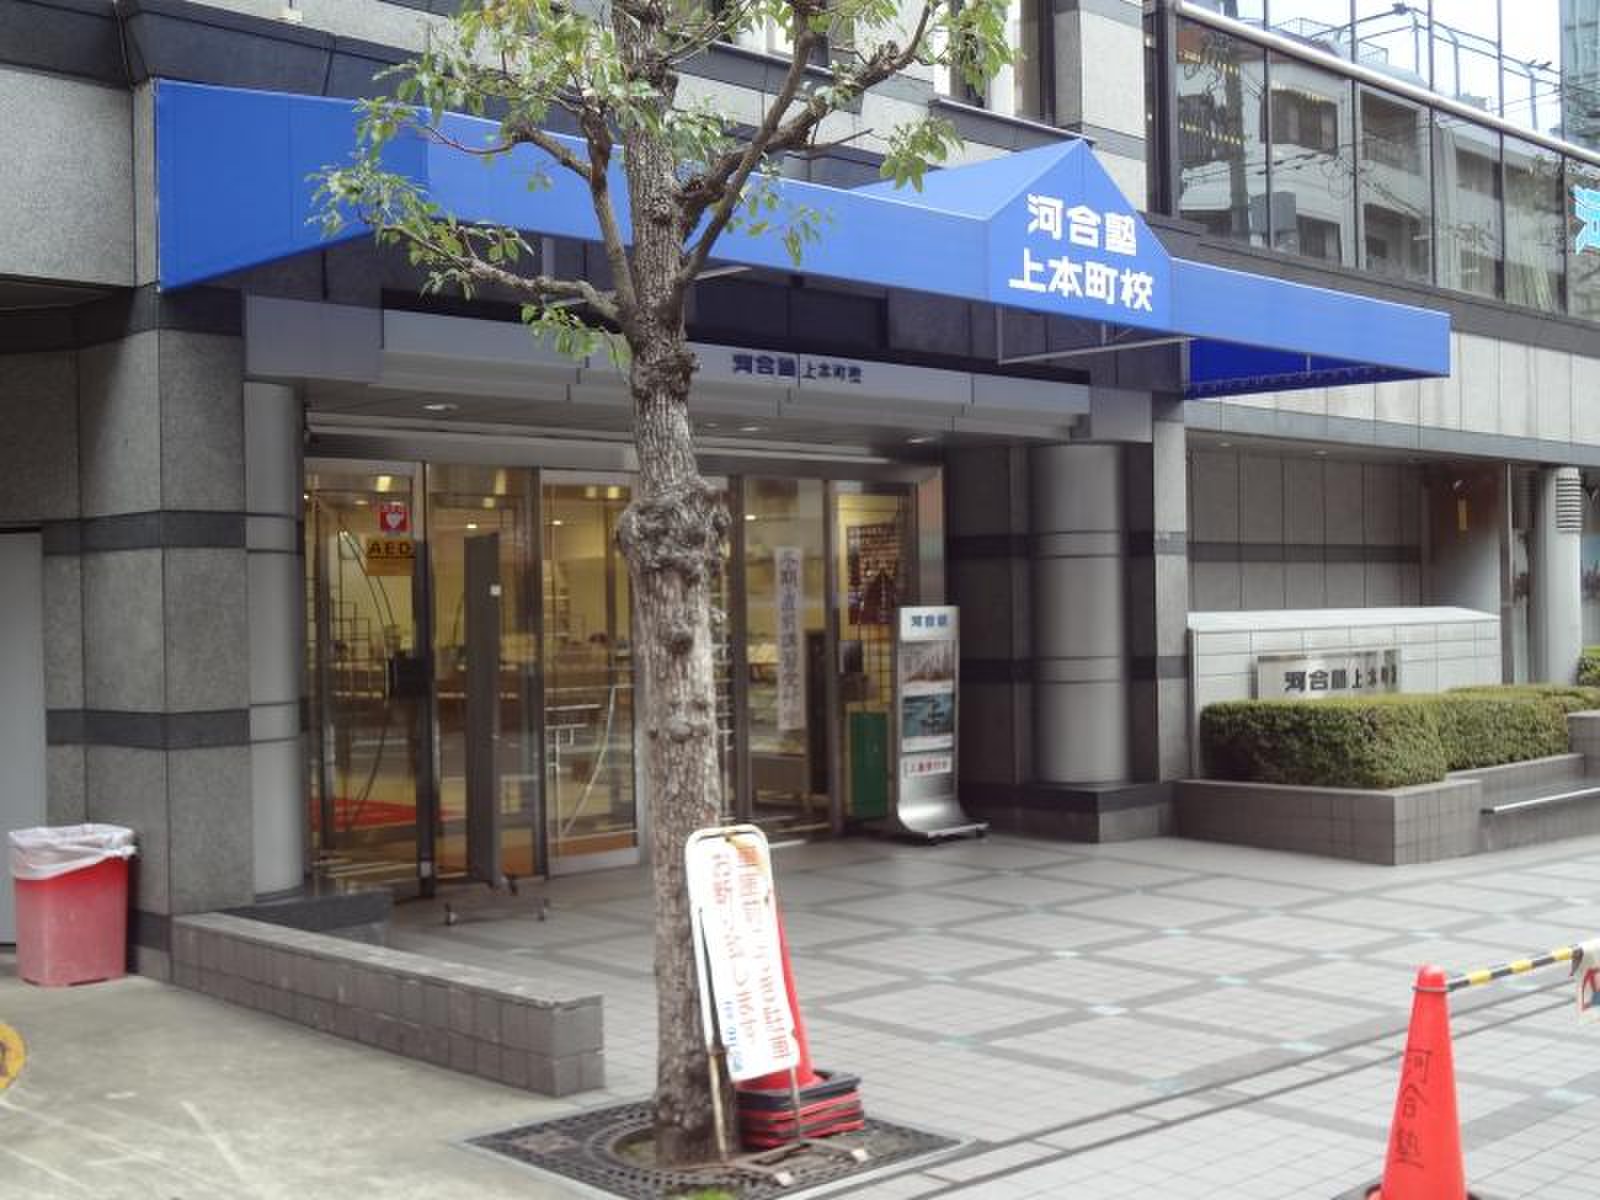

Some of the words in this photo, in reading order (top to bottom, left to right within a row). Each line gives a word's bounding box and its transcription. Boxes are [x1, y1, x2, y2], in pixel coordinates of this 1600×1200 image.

[1025, 193, 1137, 256] 河合塾
[1008, 247, 1153, 312] 上本町校
